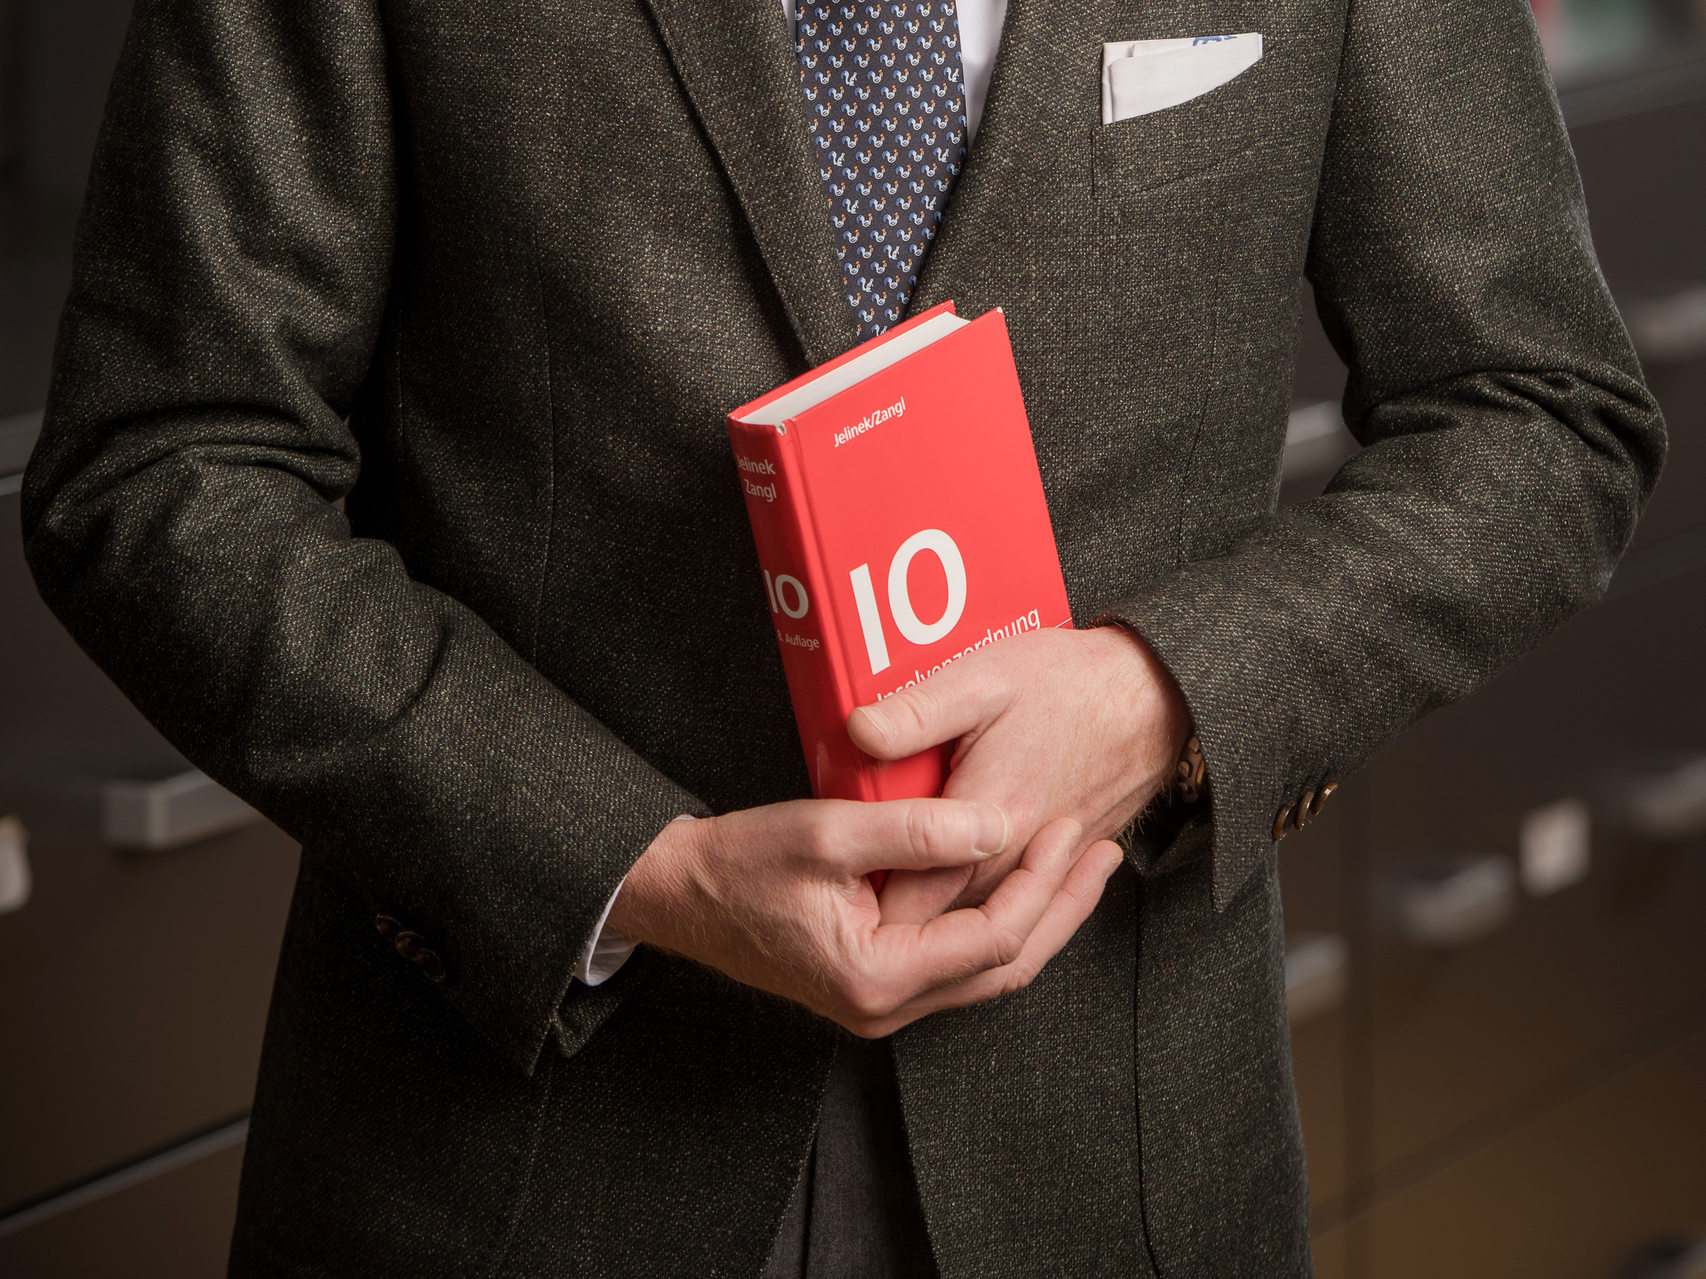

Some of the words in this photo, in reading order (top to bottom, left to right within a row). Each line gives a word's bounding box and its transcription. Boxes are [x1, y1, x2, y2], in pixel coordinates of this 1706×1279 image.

[834, 396, 906, 448] Jelinek/Zangl
[736, 454, 777, 475] Jelinek
[744, 478, 777, 503] Zangl
[785, 632, 820, 651] Auflage
[877, 608, 1041, 702] lvrdnung
